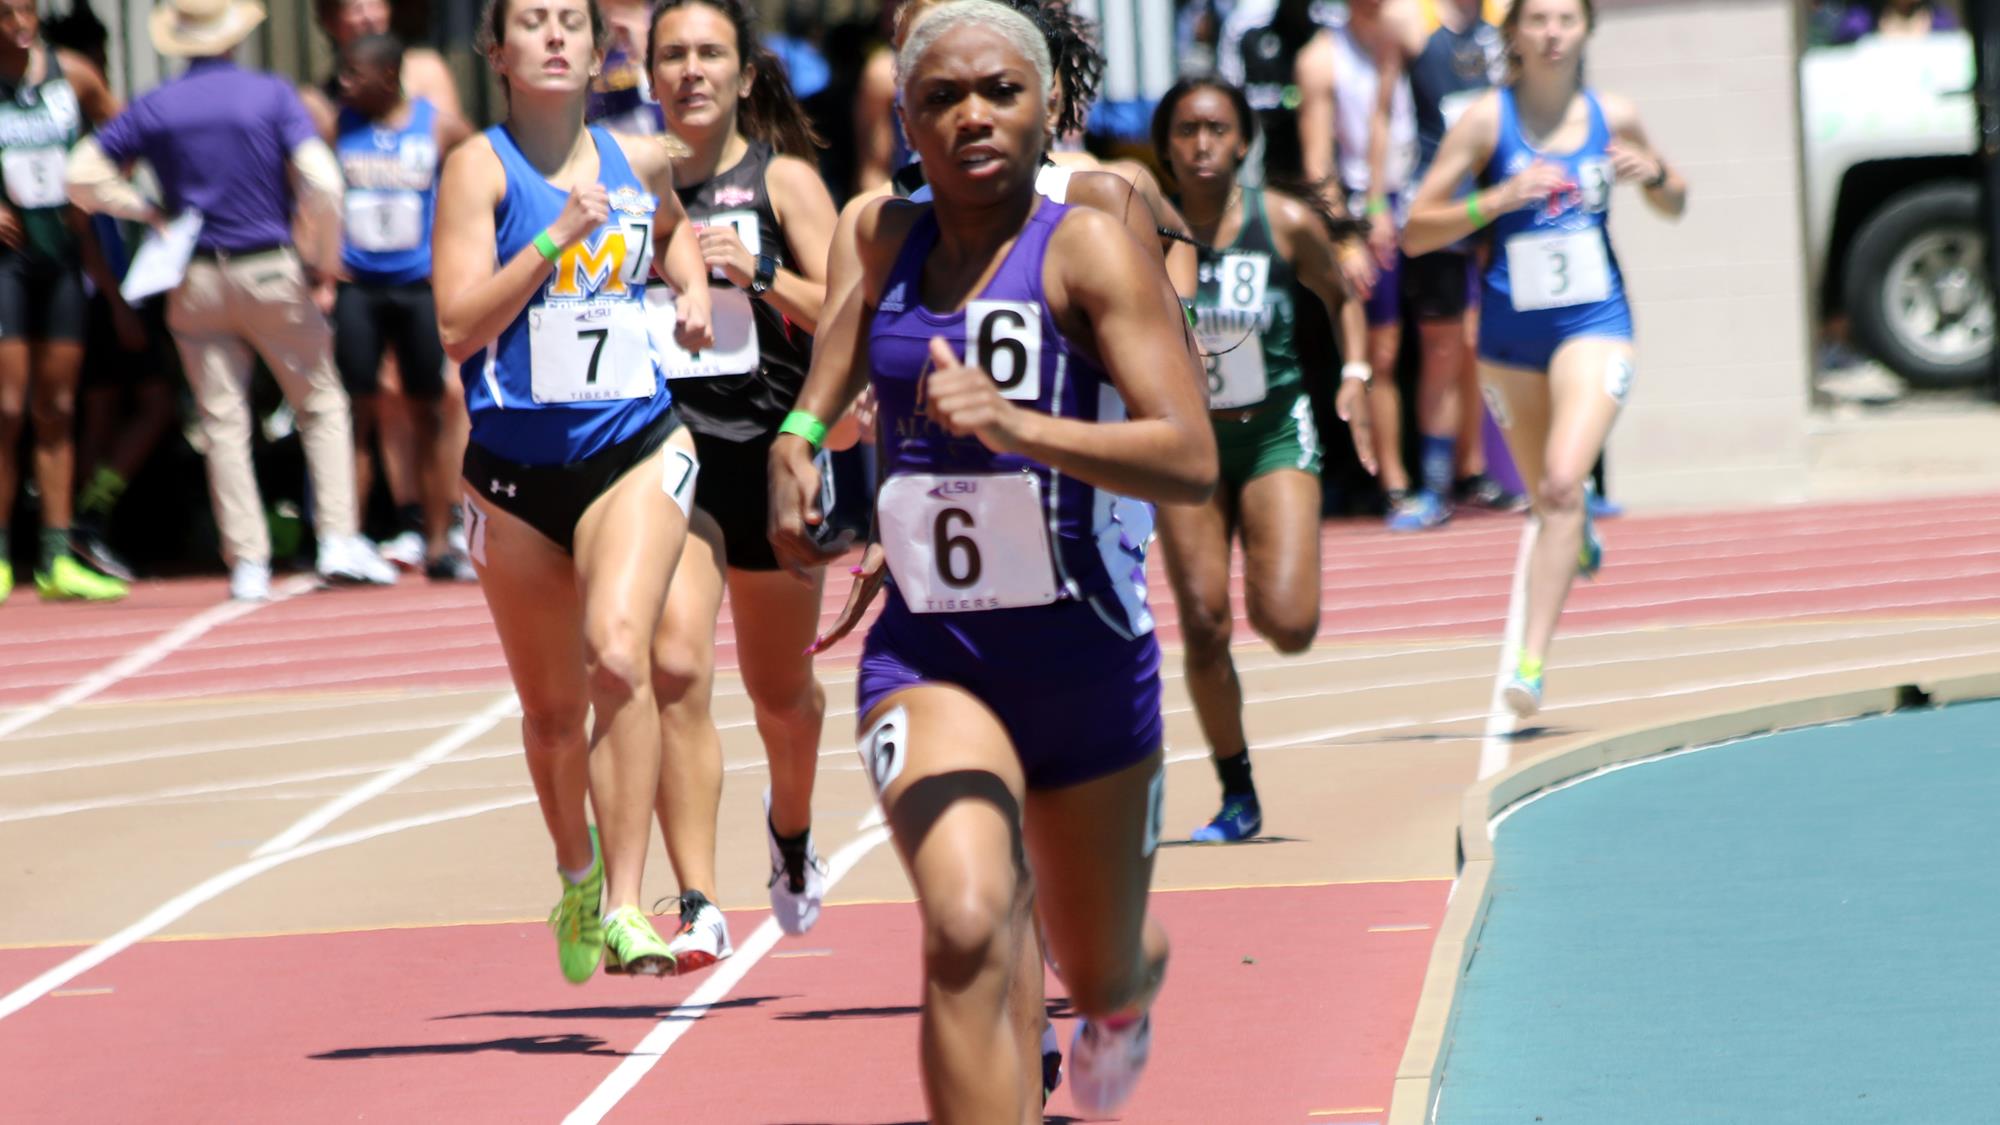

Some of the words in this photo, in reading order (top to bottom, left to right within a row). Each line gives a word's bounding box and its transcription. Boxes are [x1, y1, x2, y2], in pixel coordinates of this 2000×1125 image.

[545, 226, 631, 299] M
[629, 223, 649, 279] 7
[1549, 252, 1569, 296] 3
[1233, 260, 1256, 306] 8
[577, 328, 608, 384] 7
[978, 308, 1028, 392] 6
[570, 390, 621, 400] TIGERS
[675, 451, 694, 498] 7
[943, 481, 979, 494] LSU
[466, 501, 479, 551] 7
[934, 507, 982, 590] 6
[925, 598, 1000, 611] TIGERS
[870, 722, 896, 785] 6
